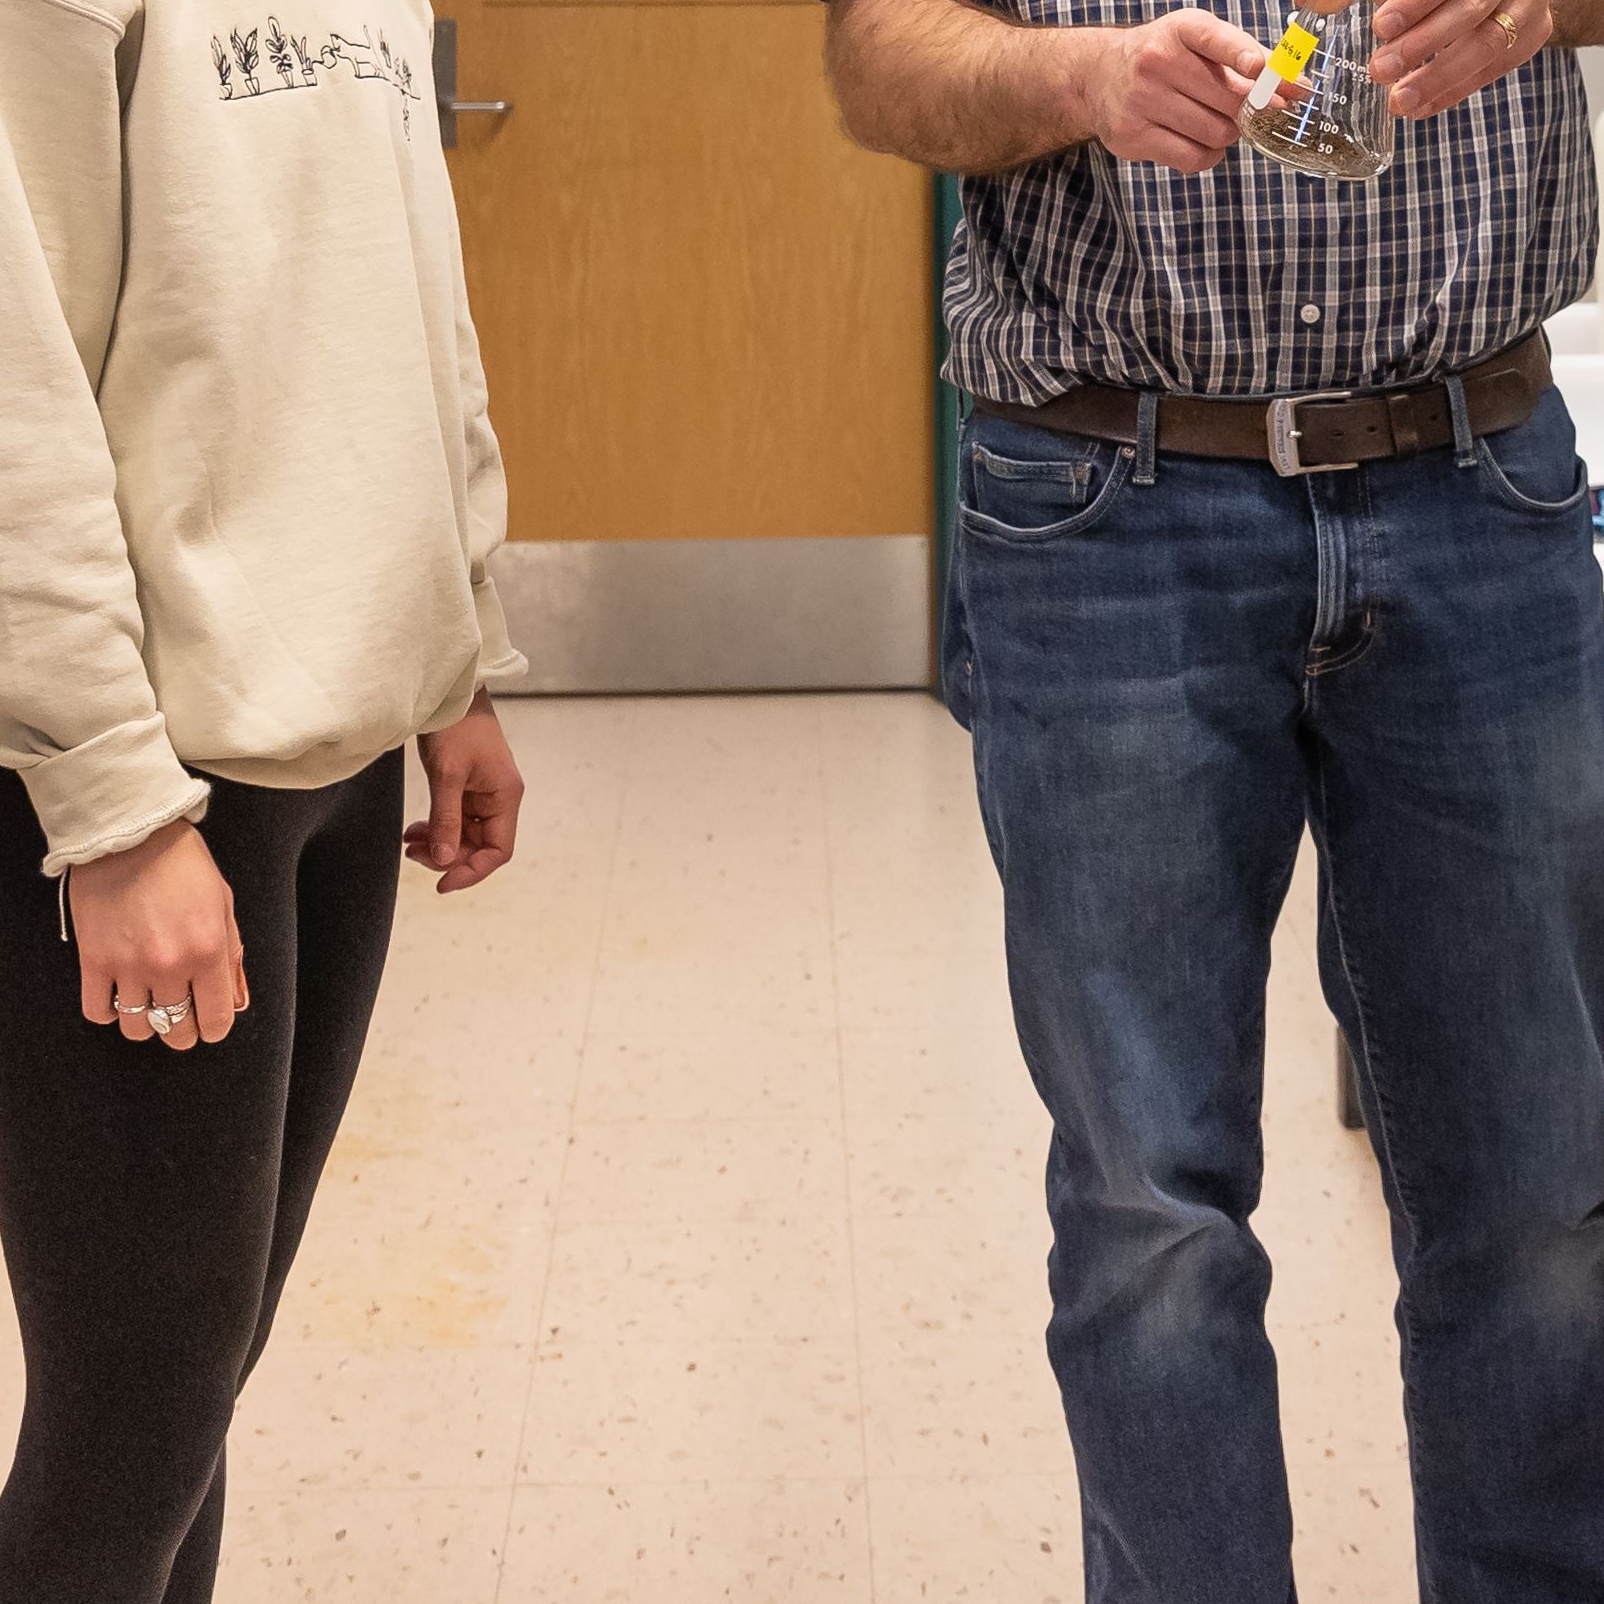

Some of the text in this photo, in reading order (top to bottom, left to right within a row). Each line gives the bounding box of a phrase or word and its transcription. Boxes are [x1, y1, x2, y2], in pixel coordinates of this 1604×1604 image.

[1335, 57, 1356, 72] 200
[1328, 92, 1347, 105] 150
[1318, 121, 1339, 134] 100
[1317, 143, 1333, 154] 50
